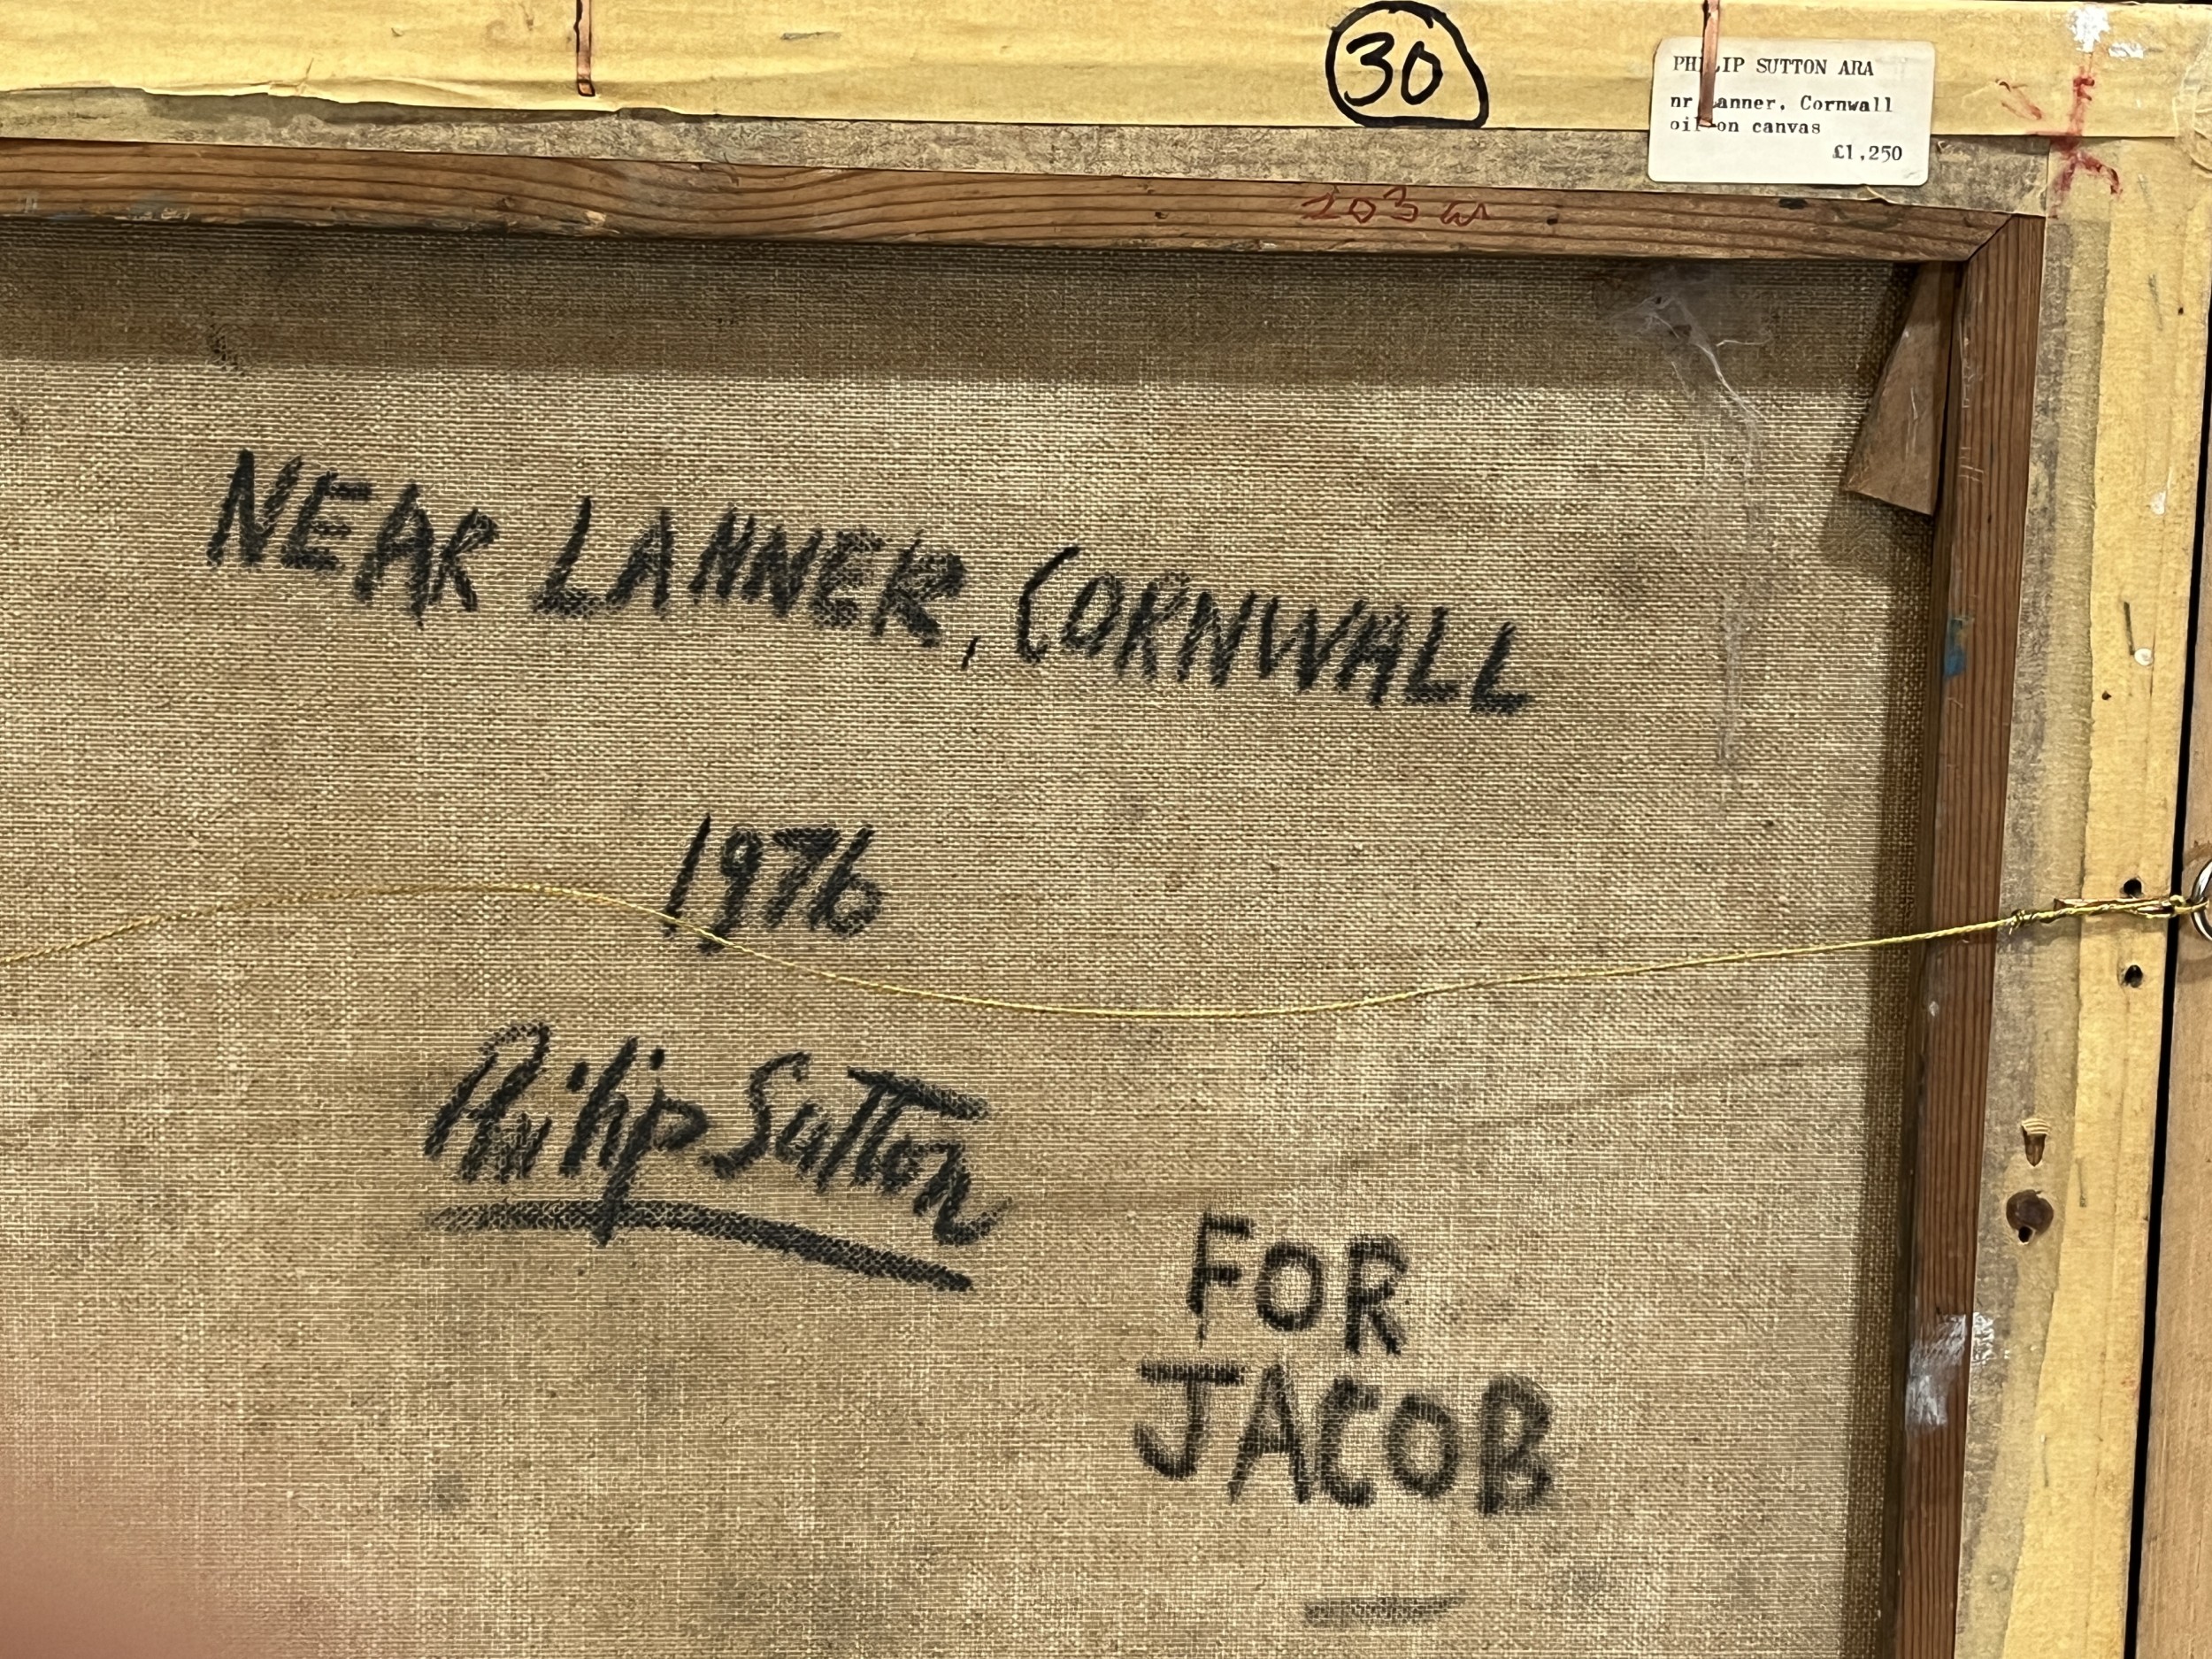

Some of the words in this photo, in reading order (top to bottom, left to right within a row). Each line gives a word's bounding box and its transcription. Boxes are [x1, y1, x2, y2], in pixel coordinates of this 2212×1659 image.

[1344, 32, 1443, 106] 30
[1671, 96, 1693, 108] nr
[1800, 95, 1893, 112] Cornwall
[1756, 58, 1827, 75] SUTTON
[1838, 59, 1874, 76] ARA
[1717, 121, 1740, 132] on
[1752, 122, 1821, 134] canvas
[1832, 144, 1903, 163] £1,250
[206, 448, 499, 624] NEAR
[1016, 544, 1529, 715] CORNWALL
[664, 814, 885, 954] 1976
[1187, 1209, 1409, 1357] FOR
[1133, 1359, 1557, 1518] JACOB
